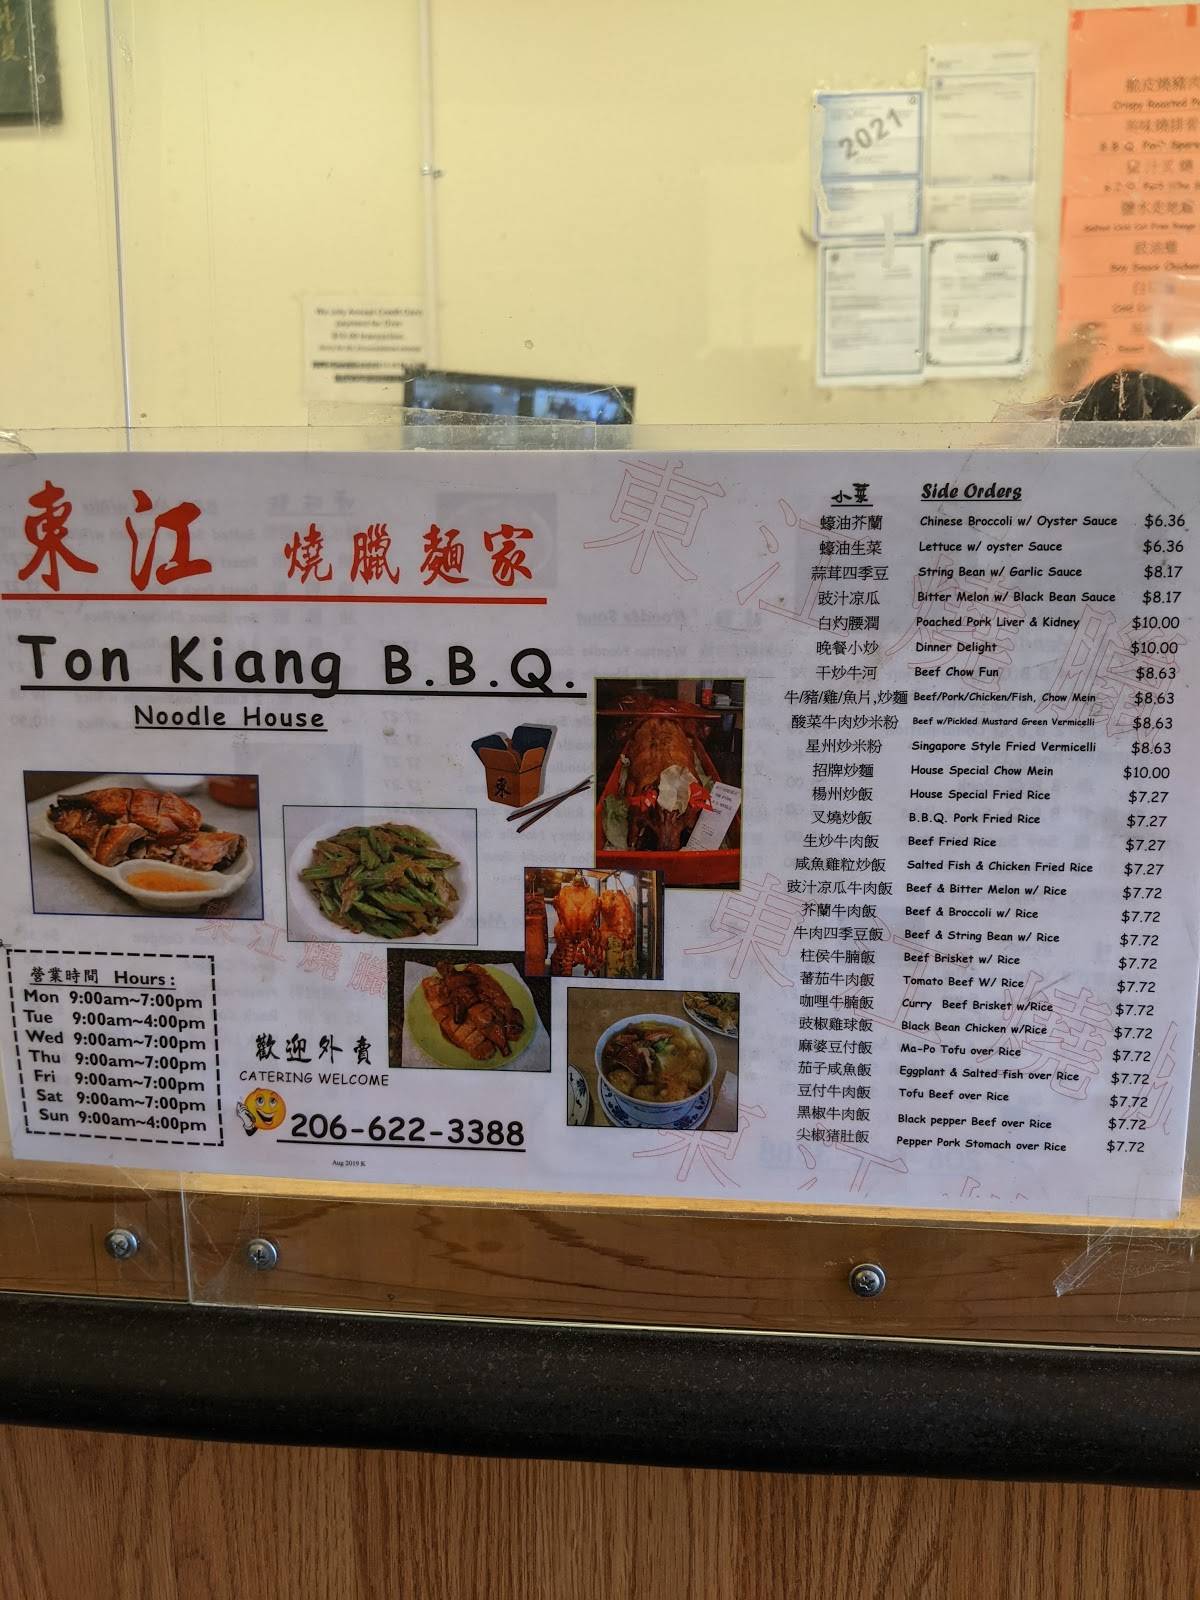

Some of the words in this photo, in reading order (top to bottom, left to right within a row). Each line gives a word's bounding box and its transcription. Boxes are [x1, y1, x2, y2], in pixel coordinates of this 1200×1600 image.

[838, 107, 903, 161] 2021
[830, 482, 871, 504] 小菜
[920, 482, 958, 499] Side
[963, 482, 1023, 499] Orders
[919, 515, 963, 527] Chinese
[967, 515, 1013, 527] Broccoli
[1017, 514, 1033, 527] w/
[1036, 514, 1078, 529] Oyster
[1082, 515, 1119, 526] Sauce
[1143, 513, 1186, 530] $6.36
[918, 540, 963, 552] Lettuce
[966, 540, 982, 552] w/
[986, 541, 1024, 555] oyster
[1027, 541, 1063, 552] Sauce
[1142, 538, 1184, 556] $6.36
[917, 566, 955, 580] String
[958, 566, 986, 577] Bean
[990, 565, 1006, 578] w/
[1009, 565, 1044, 577] Garlic
[1047, 566, 1083, 577] Sauce
[1143, 564, 1184, 581] $8.17
[915, 641, 953, 653] Dinner
[956, 641, 999, 656] Delight
[1129, 640, 1179, 657] $10.00
[17, 634, 130, 683] Ton
[171, 635, 341, 698] Kiang
[384, 645, 576, 694] B.B.Q.
[913, 665, 942, 678] Beef
[945, 666, 975, 678] Chow
[978, 666, 999, 678] Fun
[1135, 665, 1177, 682] $8.63
[913, 691, 1037, 704] Beef/Pork/Chicken/Fish,
[1041, 692, 1068, 703] Chow
[1071, 692, 1096, 704] Mein
[1133, 690, 1175, 707] $8.63
[134, 705, 226, 728] Noodle
[243, 706, 326, 729] House
[912, 716, 934, 726] Beef
[936, 716, 978, 726] w/Pickled
[981, 716, 1019, 726] Mustard
[1021, 717, 1049, 726] Green
[1051, 717, 1096, 729] Vermicelli
[1132, 715, 1173, 732] $8.63
[911, 740, 967, 754] Singapore
[970, 740, 1001, 754] Style
[1005, 740, 1037, 752] Fried
[1040, 741, 1096, 753] Vermicelli
[1130, 740, 1172, 757] $8.63
[910, 764, 944, 775] House
[948, 764, 989, 778] Special
[993, 764, 1023, 776] Chow
[1026, 765, 1054, 777] Mein
[1122, 765, 1171, 781] $10.00
[908, 812, 949, 825] B.B.Q.
[953, 812, 979, 824] Pork
[982, 812, 1013, 824] Fried
[1017, 813, 1041, 825] Rice
[1126, 813, 1168, 829] $7.27
[907, 835, 935, 847] Beef
[938, 836, 969, 847] Fried
[972, 836, 997, 848] Rice
[1124, 837, 1167, 853] $7.27
[905, 905, 932, 917] Beef
[935, 906, 944, 917] &
[948, 906, 992, 918] Broccoli
[996, 907, 1011, 918] w/
[1015, 908, 1039, 919] Rice
[1120, 909, 1161, 925] $7.72
[30, 966, 99, 985] 營業時間
[902, 975, 944, 986] Tomato
[947, 976, 975, 988] Beef
[978, 977, 998, 988] W/
[1001, 977, 1025, 988] Rice
[1116, 979, 1156, 995] $7.72
[23, 988, 60, 1004] Mon
[22, 1008, 54, 1024] Tue
[24, 1029, 64, 1045] Wed
[901, 1019, 930, 1032] Black
[934, 1021, 961, 1032] Bean
[964, 1022, 1007, 1034] Chicken
[1010, 1024, 1048, 1035] w/Rice
[1113, 1025, 1153, 1041] $7.72
[27, 1048, 61, 1064] Thu
[255, 1033, 373, 1065] 歡迎外賣
[900, 1042, 936, 1054] Ma-Po
[939, 1044, 966, 1055] Tofu
[969, 1047, 995, 1056] over
[998, 1046, 1022, 1057] Rice
[1111, 1048, 1152, 1064] $7.72
[33, 1068, 57, 1083] Fri
[239, 1070, 313, 1084] CATERING
[319, 1073, 390, 1087] WELCOME
[36, 1088, 64, 1103] Sat
[898, 1087, 925, 1099] Tofu
[928, 1088, 955, 1100] Beef
[958, 1092, 983, 1101] over
[986, 1091, 1010, 1102] Rice
[1109, 1093, 1149, 1109] $7.72
[38, 1107, 70, 1123] Sun
[897, 1113, 927, 1124] Black
[930, 1117, 967, 1128] pepper
[971, 1116, 998, 1128] Beef
[1001, 1120, 1025, 1128] over
[1028, 1118, 1053, 1129] Rice
[1107, 1116, 1147, 1132] $7.72
[291, 1112, 526, 1147] 206-622-3388
[896, 1135, 933, 1149] Pepper
[936, 1137, 961, 1148] Pork
[964, 1138, 1012, 1150] Stomach
[1015, 1143, 1040, 1151] over
[1043, 1141, 1067, 1152] Rice
[1106, 1139, 1145, 1154] $7.72
